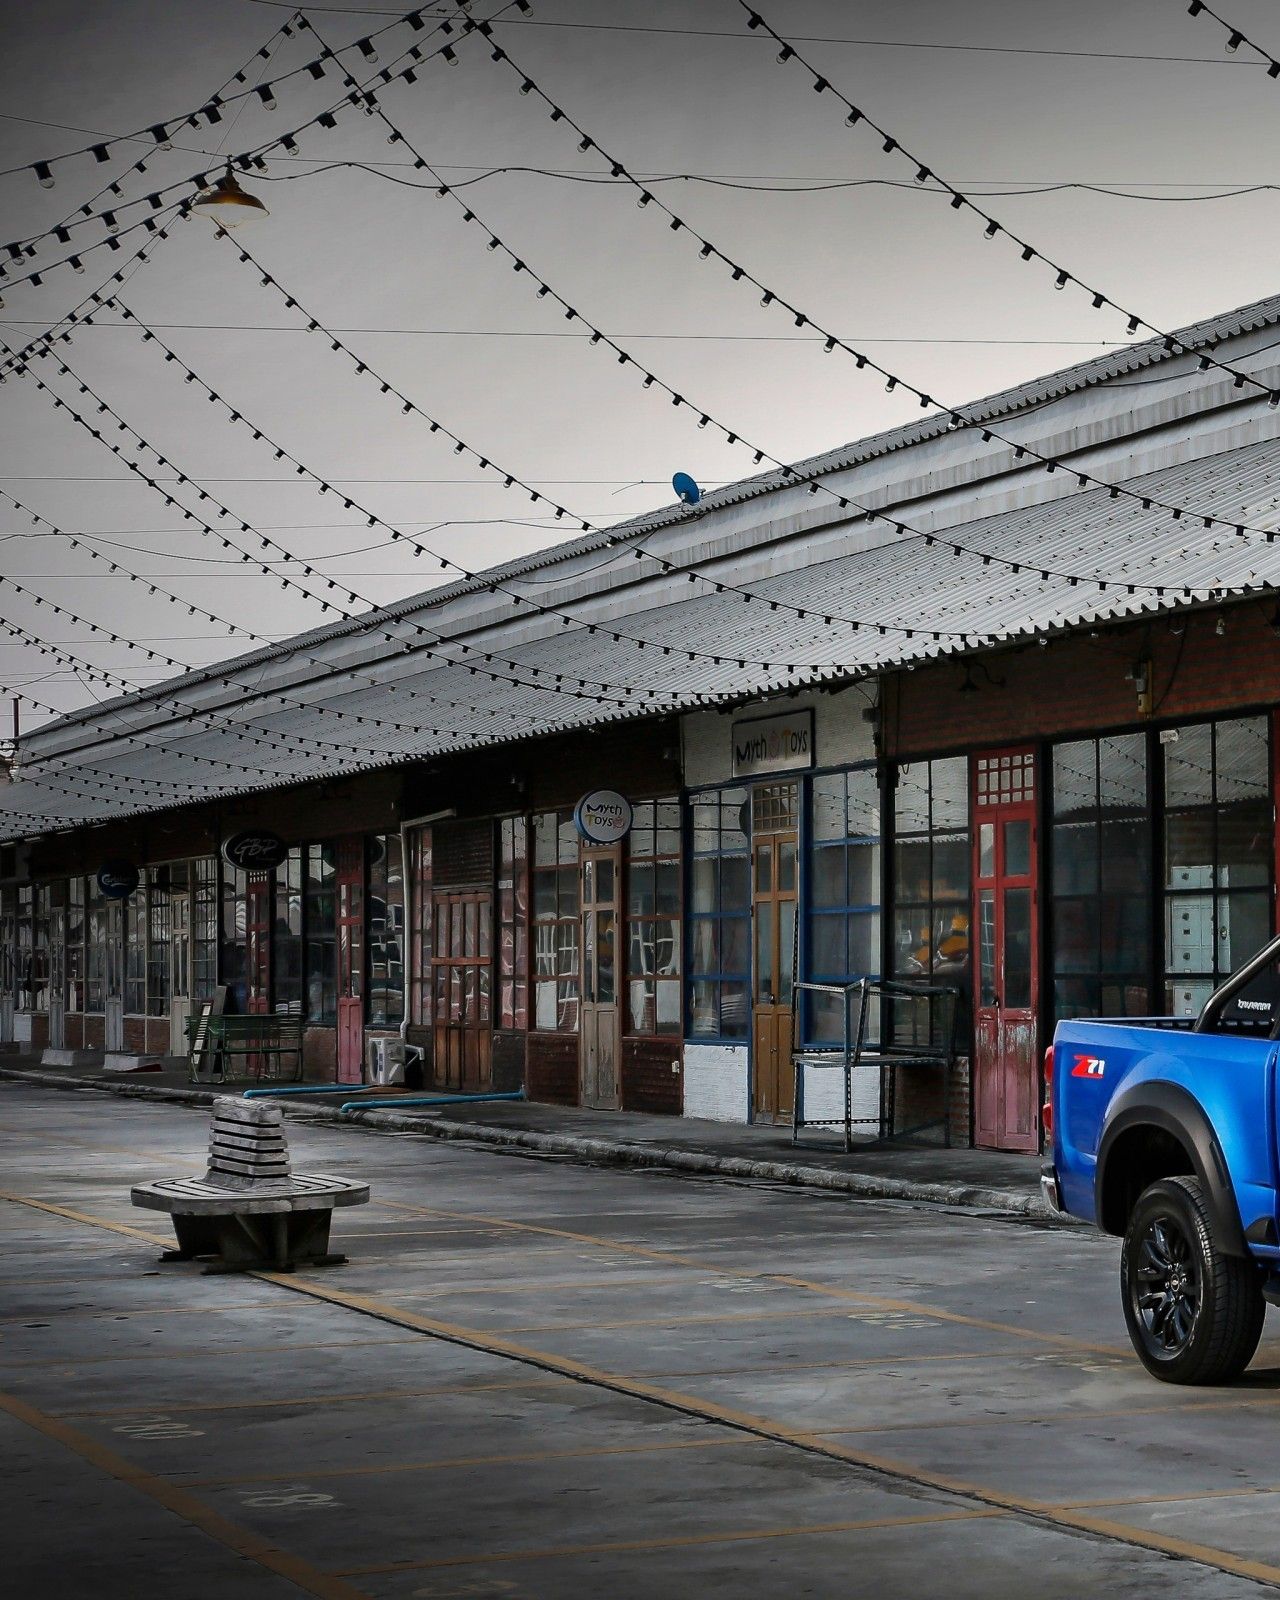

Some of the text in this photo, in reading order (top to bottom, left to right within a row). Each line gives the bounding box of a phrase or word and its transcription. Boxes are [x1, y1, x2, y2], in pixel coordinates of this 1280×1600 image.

[736, 728, 808, 767] Myth Toys
[586, 803, 623, 816] Myth
[585, 814, 613, 827] Toys
[1071, 1055, 1105, 1079] Z71
